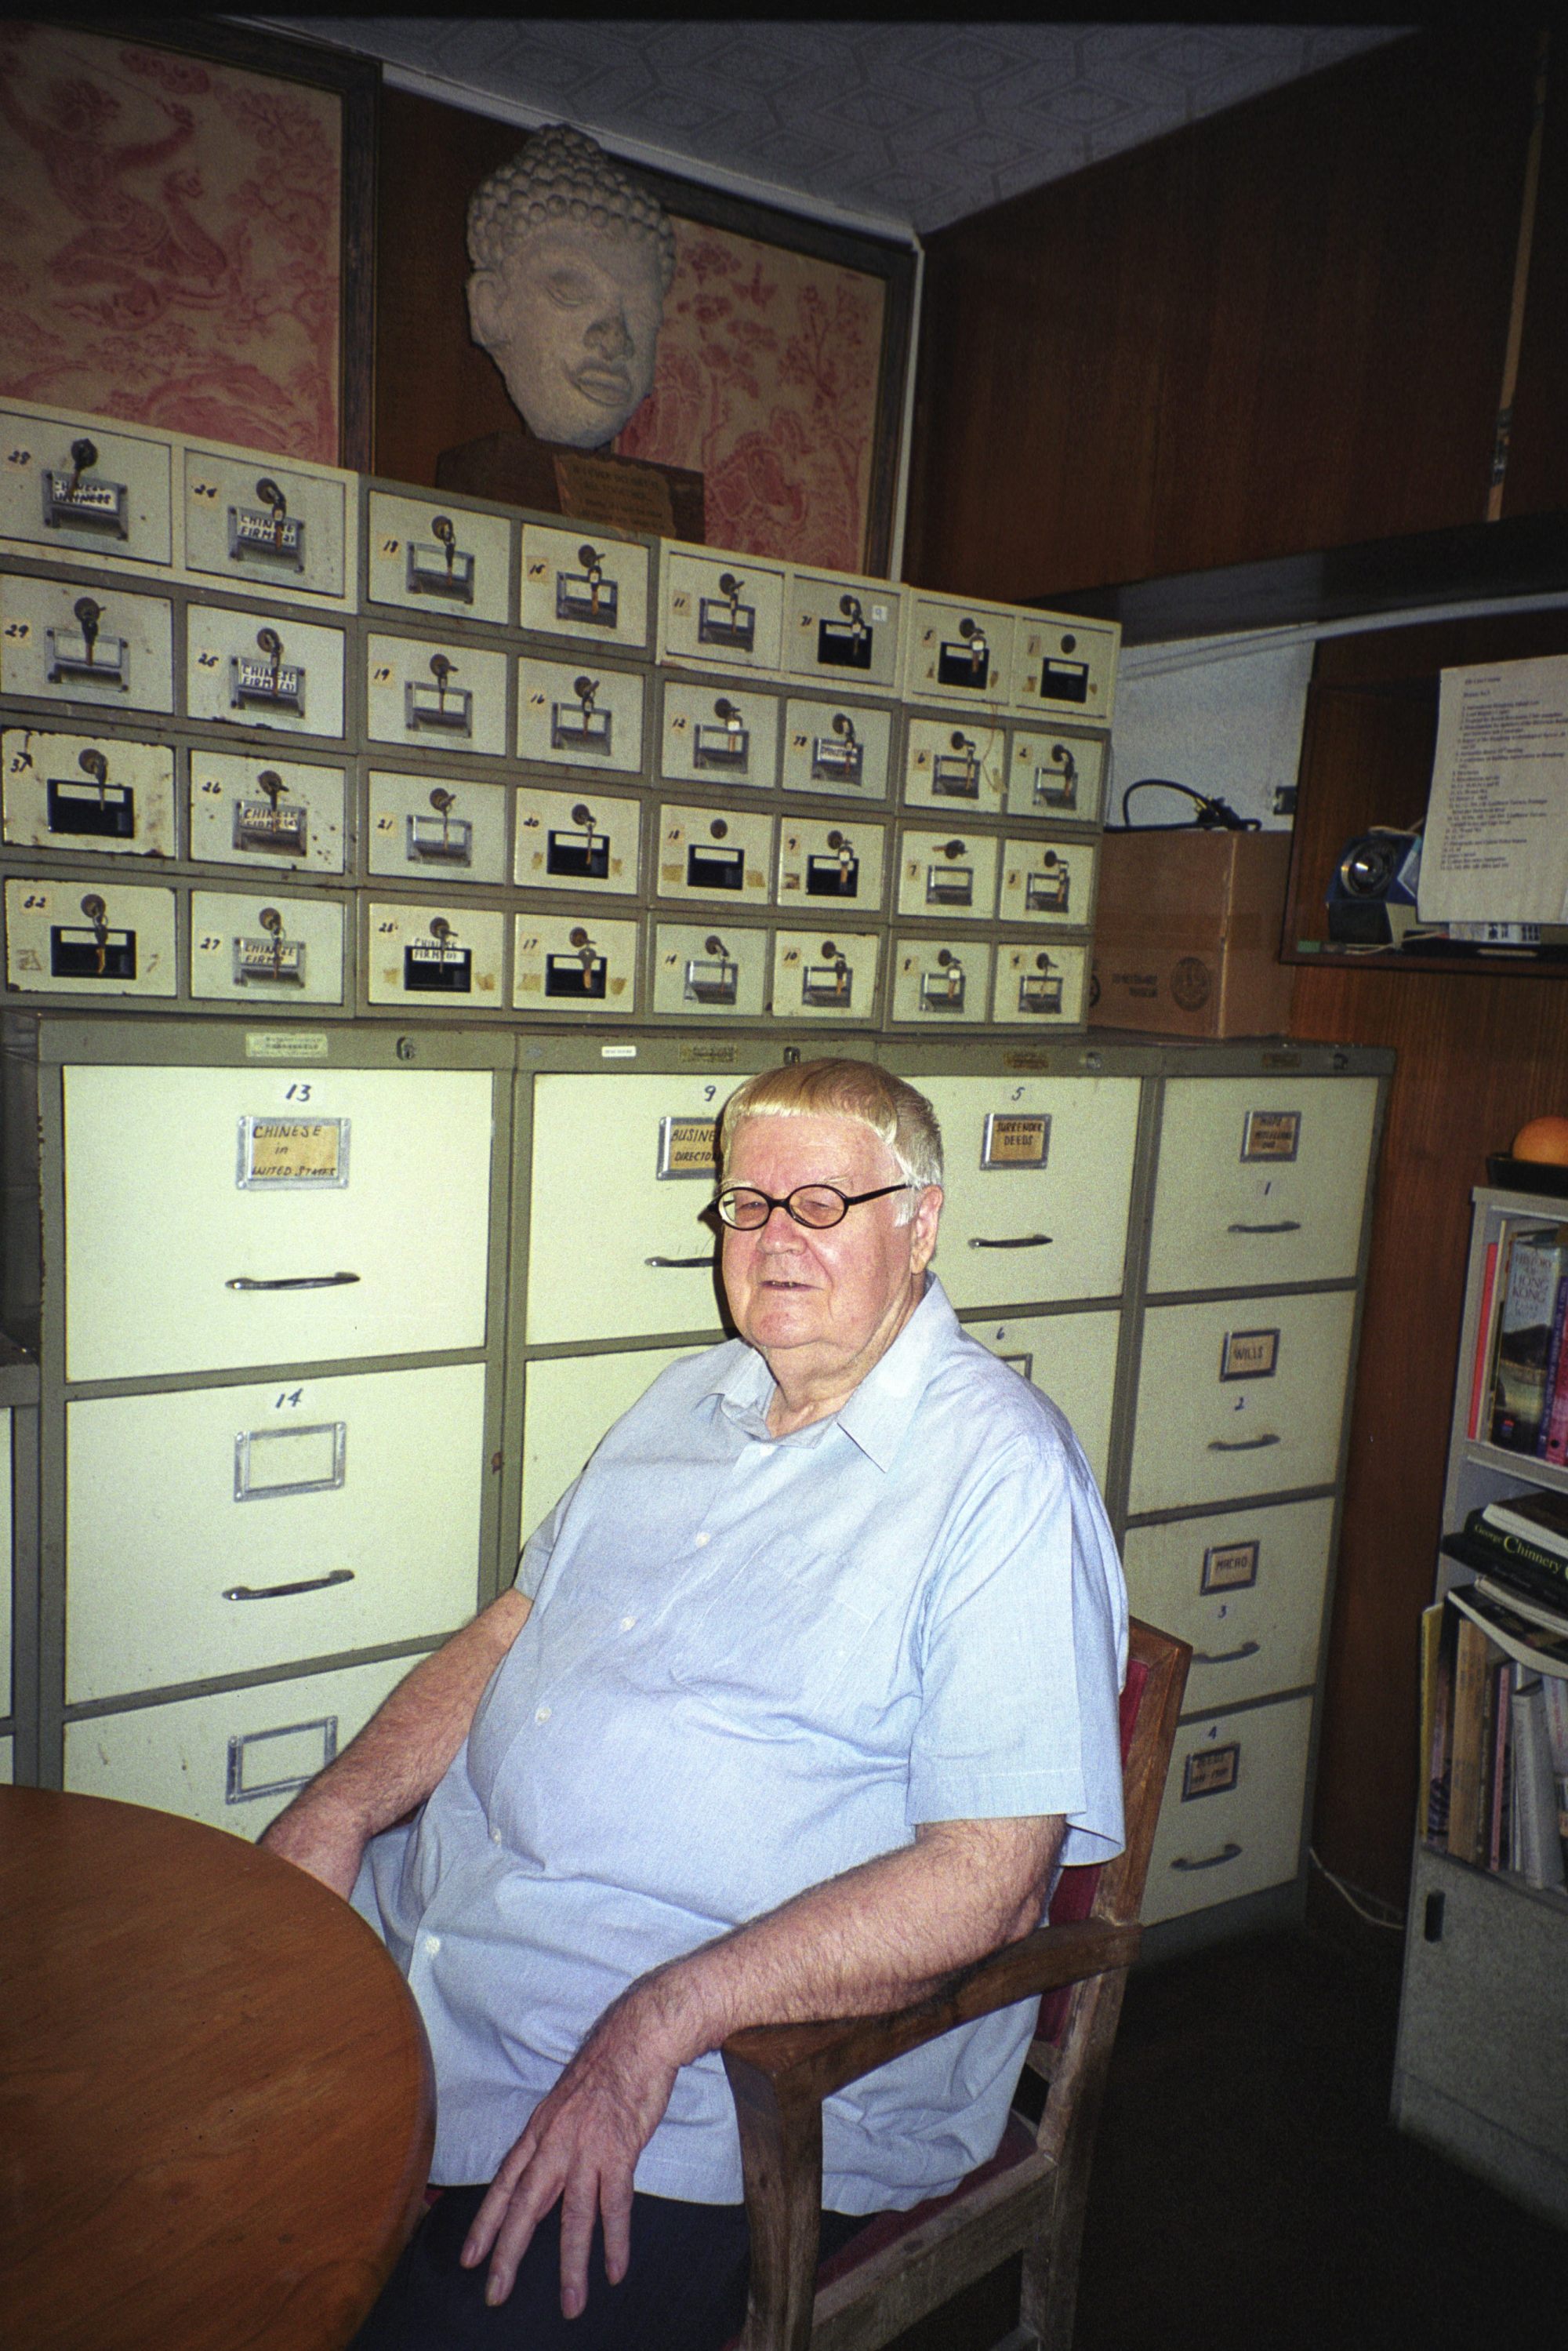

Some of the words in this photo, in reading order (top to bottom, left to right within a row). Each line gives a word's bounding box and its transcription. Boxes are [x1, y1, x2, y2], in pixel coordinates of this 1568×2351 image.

[201, 938, 220, 950] 27
[285, 1084, 311, 1102] 13
[705, 1085, 717, 1102] 9
[253, 1125, 321, 1139] CHINESE
[996, 1327, 1005, 1340] 6
[1233, 1346, 1263, 1360] WILLS
[275, 1388, 303, 1408] 14
[1504, 1535, 1563, 1575] Chinnery
[1208, 1726, 1218, 1739] 4
